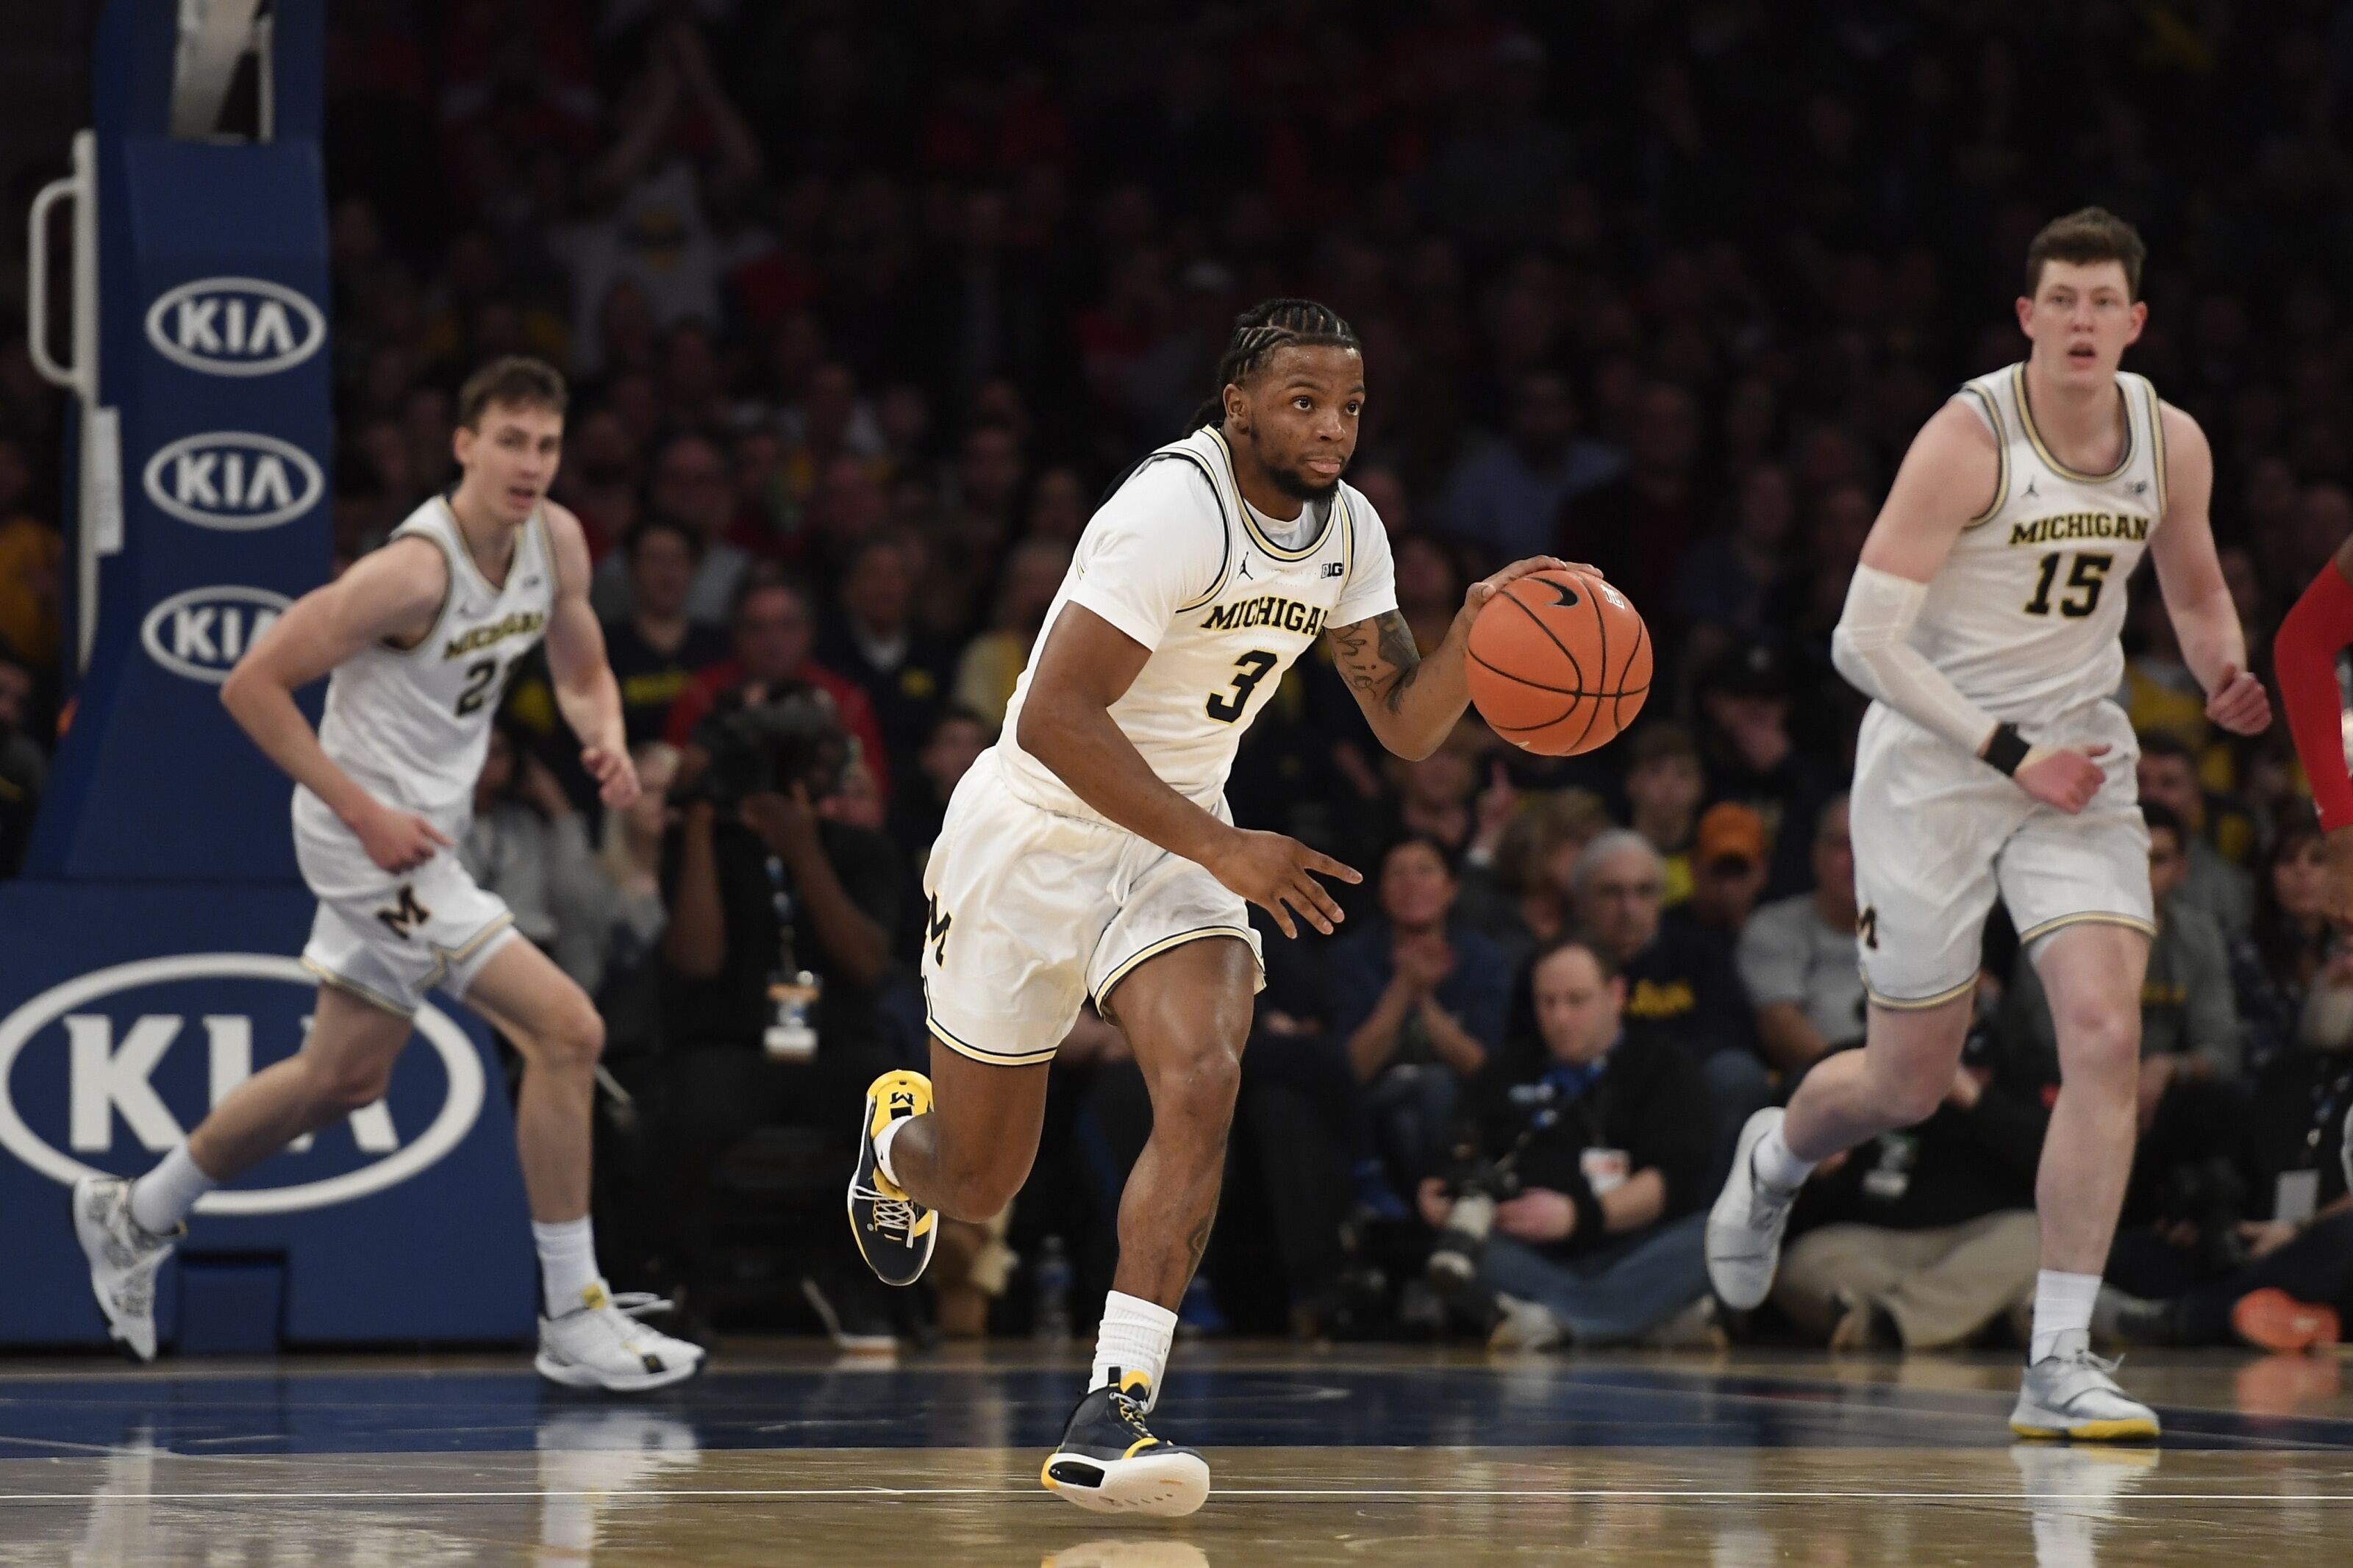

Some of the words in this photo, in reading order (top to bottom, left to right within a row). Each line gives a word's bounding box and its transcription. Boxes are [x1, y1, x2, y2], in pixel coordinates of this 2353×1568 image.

[178, 298, 294, 354] KIA
[176, 452, 293, 509] KIA
[2009, 512, 2149, 545] MICHIGAN
[2024, 551, 2113, 617] 15
[1204, 648, 1278, 725] 3
[376, 884, 431, 941] M
